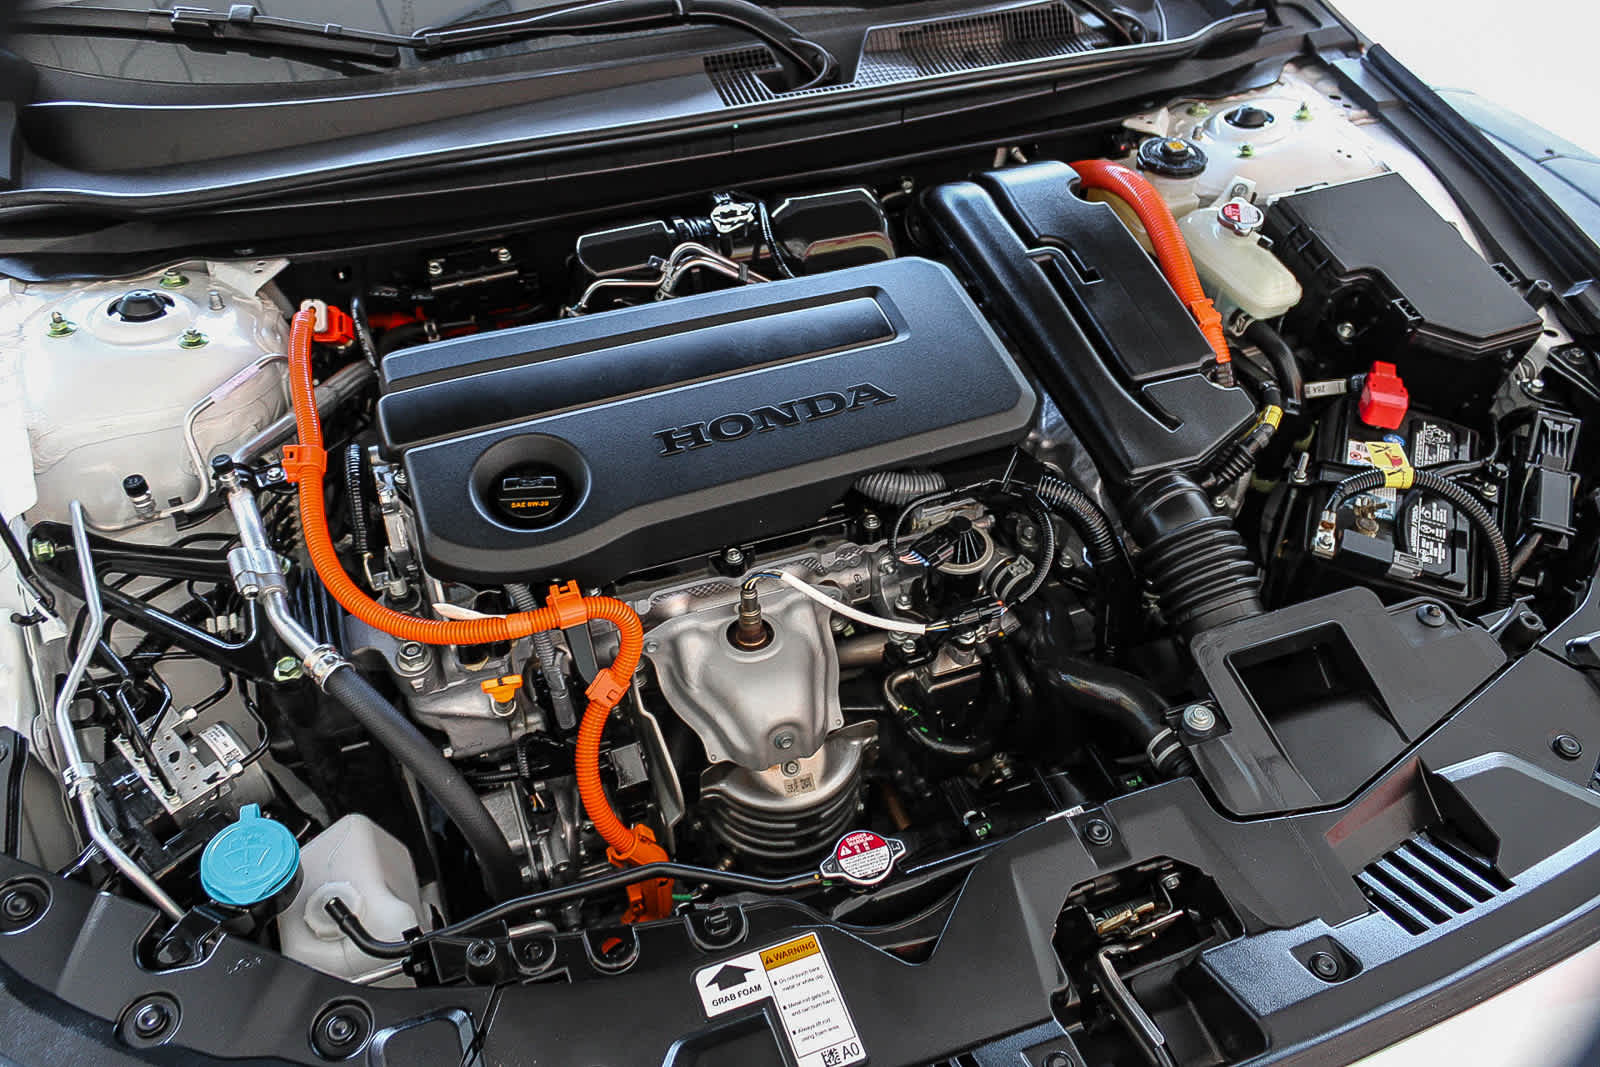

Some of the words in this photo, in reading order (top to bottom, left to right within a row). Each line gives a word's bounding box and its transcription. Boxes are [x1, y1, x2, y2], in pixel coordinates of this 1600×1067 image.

[652, 382, 897, 457] HONDA
[773, 940, 816, 961] WARNING
[712, 993, 736, 1007] GRAB
[738, 984, 762, 999] FOAM
[843, 1042, 860, 1060] A0
